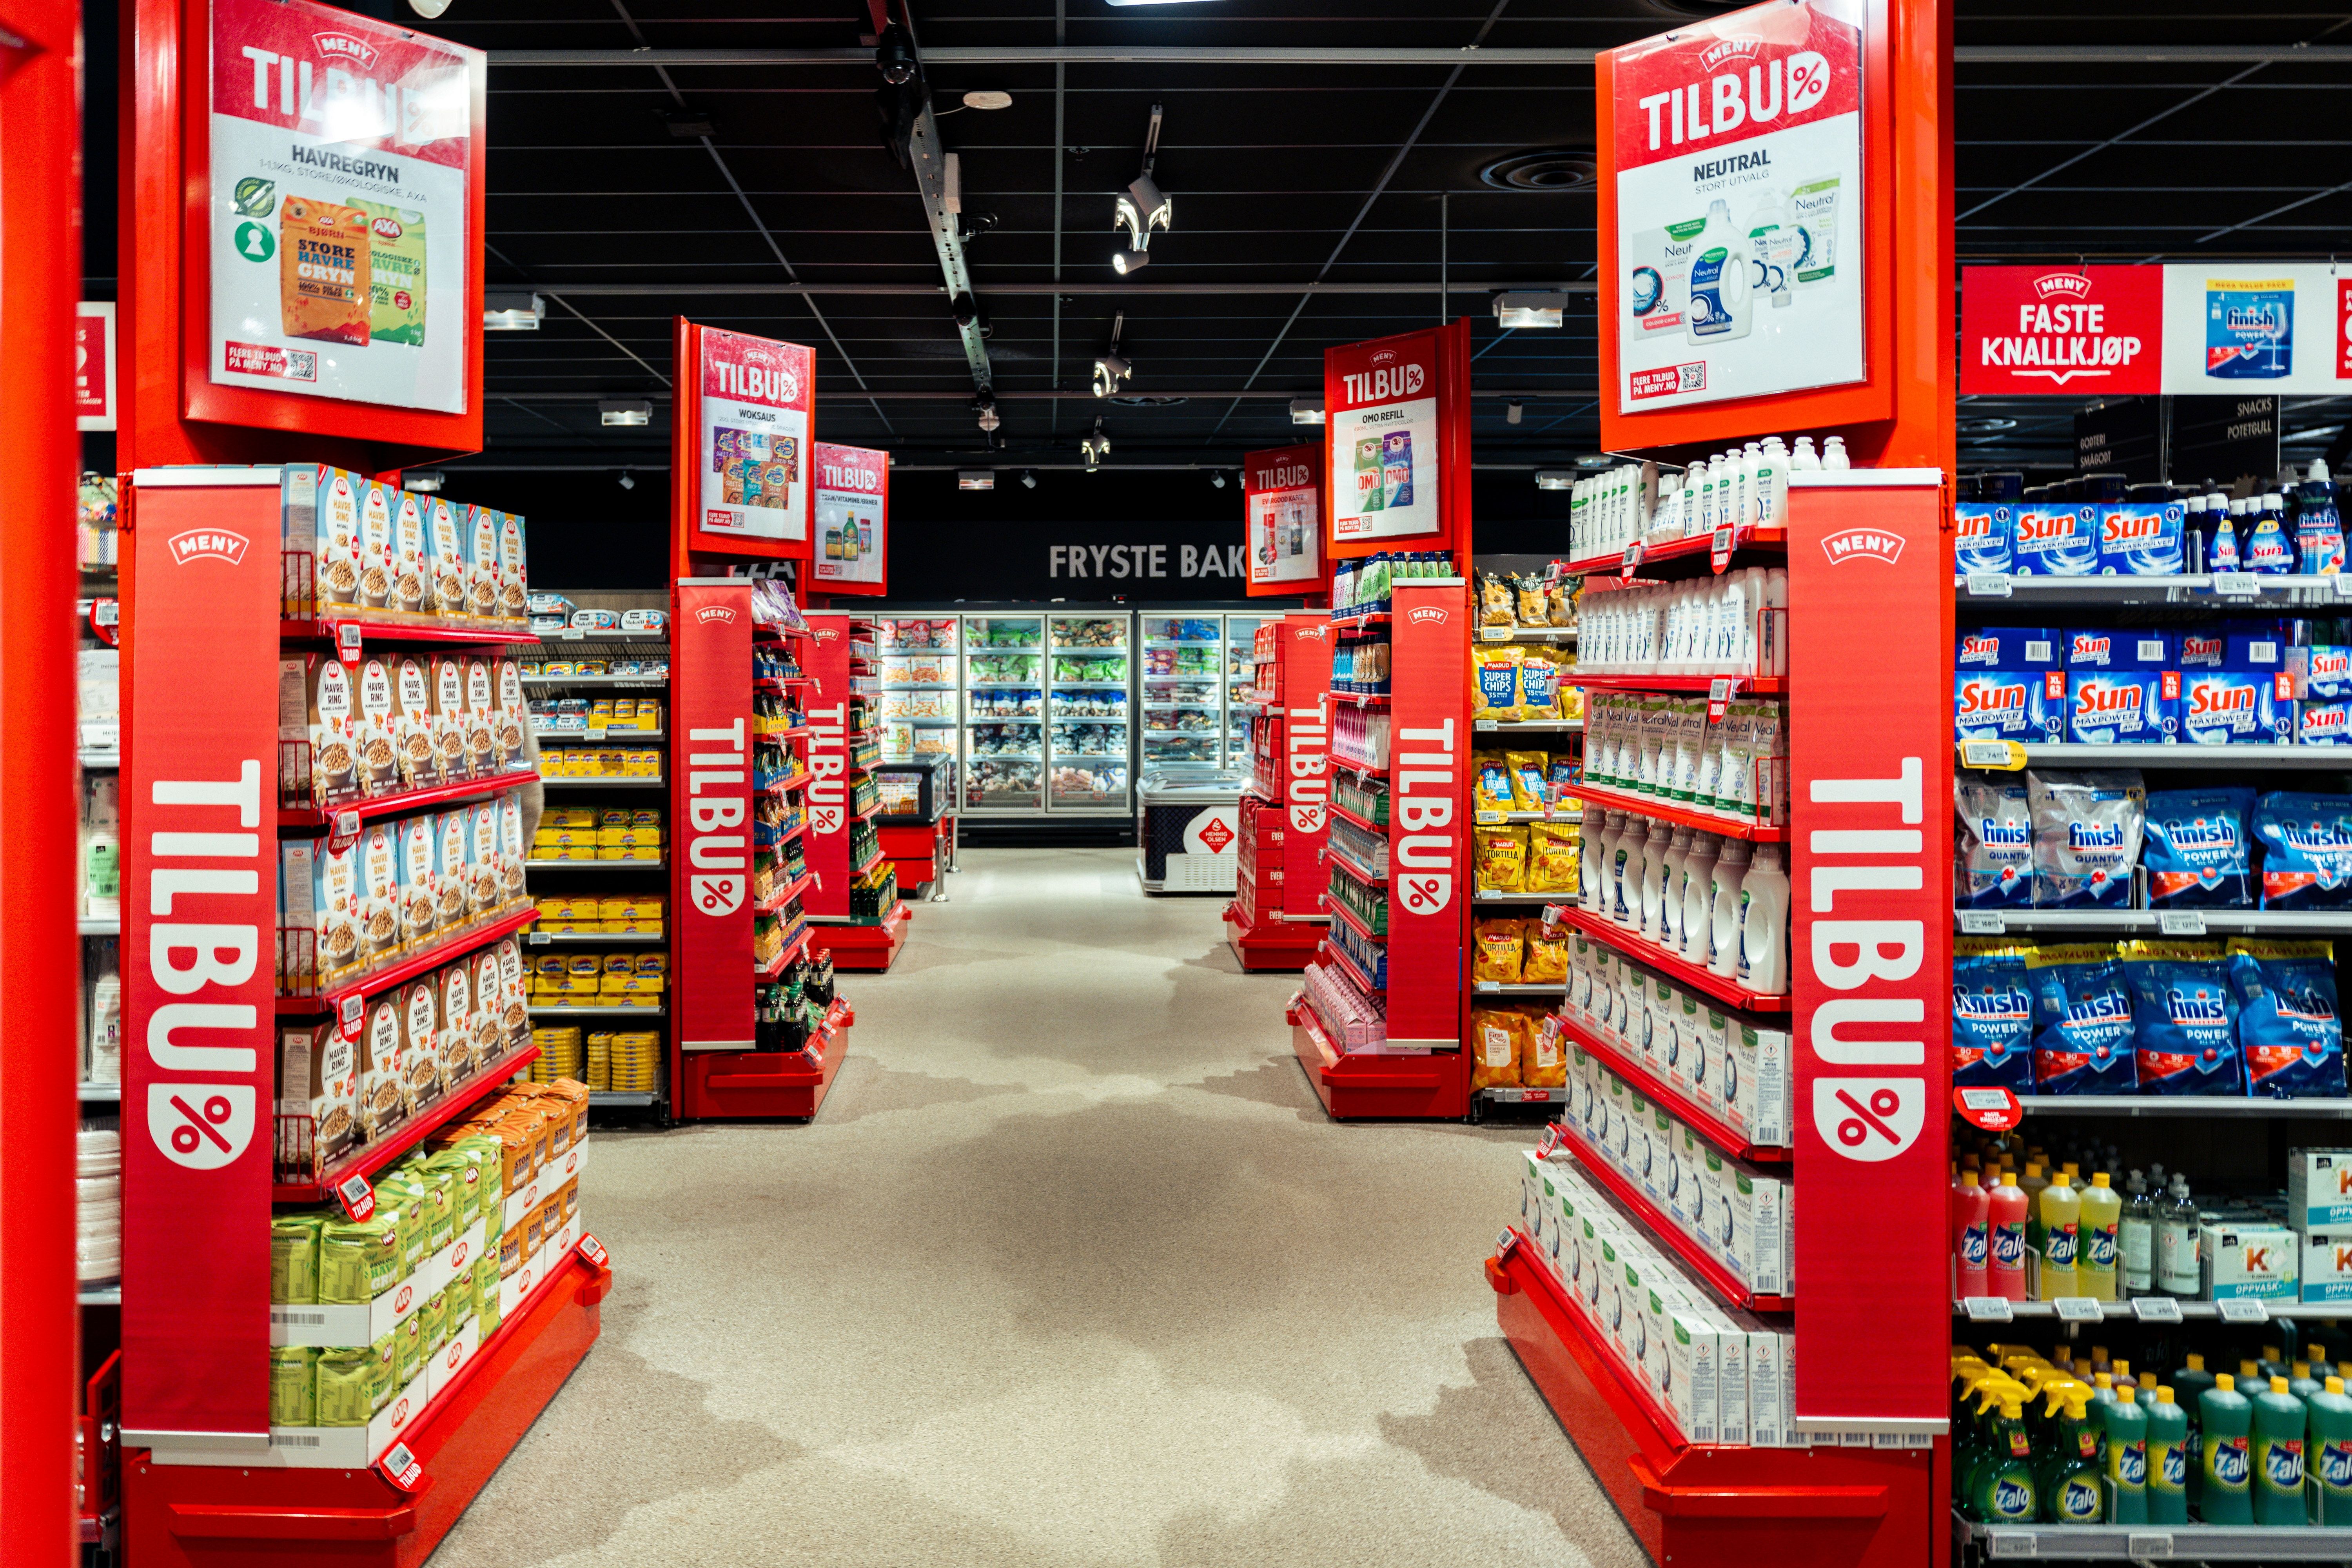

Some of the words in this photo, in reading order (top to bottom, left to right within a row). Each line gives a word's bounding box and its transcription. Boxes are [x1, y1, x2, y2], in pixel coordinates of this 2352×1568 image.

[321, 37, 372, 60] MENY
[1707, 40, 1757, 64] MENY
[291, 145, 399, 183] HAVREGRYN
[1693, 149, 1771, 183] NEUTRAL
[1695, 181, 1728, 195] STORT
[1729, 169, 1770, 188] UTVALG
[407, 191, 427, 203] AXA
[1795, 192, 1835, 211] Neutral
[319, 217, 334, 225] AXA
[373, 220, 402, 236] AXA
[309, 227, 344, 239] BJØRN
[298, 239, 355, 258] STORE
[298, 252, 355, 270] HAVRE
[298, 263, 354, 285] GRYN
[1695, 266, 1719, 277] Neutral
[2042, 280, 2086, 292] MENY
[2020, 304, 2104, 334] FASTE
[2228, 307, 2274, 325] finish
[229, 347, 253, 358] FLERE
[254, 351, 282, 363] TILBUD
[747, 352, 771, 365] MENY
[1373, 353, 1394, 363] MENY
[1982, 336, 2141, 367] KNALLKJØP
[229, 358, 241, 368] PÅ
[243, 359, 283, 373] MENY.NO
[1633, 375, 1651, 386] FLERE
[1651, 371, 1675, 383] TILBUD
[1633, 384, 1643, 396] PÅ
[1644, 380, 1677, 394] MENY.NO
[2237, 397, 2272, 417] SNACKS
[739, 409, 776, 422] WOKSAUS
[1363, 414, 1379, 423] OMO
[1381, 410, 1404, 421] REFILL
[2227, 419, 2272, 440] POTETGULL
[2080, 433, 2106, 450] GODTERI
[2080, 450, 2111, 469] SMÅGODT
[1358, 474, 1381, 490] OMO
[1385, 468, 1409, 485] OMO
[333, 499, 351, 511] HAVRE
[1262, 496, 1288, 505] EVERGOOD
[336, 512, 349, 523] RING
[2017, 514, 2076, 542] Sun
[2103, 514, 2161, 542] Sun
[178, 534, 240, 556] MENY
[1831, 534, 1895, 555] MENY
[2105, 537, 2173, 554] OPPVASKPULVER
[2253, 544, 2283, 559] Sun
[1050, 544, 1167, 578] FRYSTE
[1713, 554, 1728, 565] TILBUD
[701, 608, 732, 619] MENY
[1413, 612, 1444, 620] MENY
[2312, 654, 2348, 675] Sun
[1484, 671, 1511, 682] SUPER
[2050, 675, 2061, 685] XL
[368, 682, 384, 692] HAVRE
[1485, 681, 1511, 692] CHIPS
[370, 693, 383, 702] RING
[1960, 682, 2026, 713] Sun
[2077, 683, 2142, 714] Sun
[2190, 684, 2256, 715] Sun
[1710, 702, 1725, 716] TILBUD
[1959, 712, 2019, 725] MAXPOWER
[2189, 714, 2249, 726] MAXPOWER
[1485, 770, 1497, 779] SOM-
[1486, 780, 1508, 789] BREROS
[2069, 821, 2123, 846] finish
[2164, 817, 2234, 845] finish
[370, 852, 388, 866] HAVRE
[1487, 850, 1518, 860] TORTILLA
[2184, 850, 2228, 861] POWER
[330, 864, 347, 877] HAVRE
[374, 864, 387, 875] RING
[1270, 871, 1284, 880] EVER
[333, 877, 347, 887] RING
[1483, 943, 1516, 952] TORTILLA
[1628, 985, 1642, 1001] Neutral
[1653, 999, 1670, 1016] Neutral
[343, 1019, 363, 1037] TILBUD
[377, 1022, 393, 1037] HAVRE
[1972, 1023, 2018, 1034] POWER
[379, 1034, 392, 1046] RING
[1706, 1028, 1724, 1046] Neutral
[329, 1046, 347, 1060] HAVRE
[1738, 1045, 1756, 1065] Neutral
[331, 1058, 345, 1069] RING
[465, 1167, 479, 1183] AXA
[352, 1199, 374, 1220] TILBUD
[1992, 1232, 2025, 1258] Zalo
[592, 1249, 606, 1265] TILBUD
[2247, 1247, 2269, 1272] K
[392, 1399, 408, 1428] AXA
[2266, 1454, 2303, 1479] Zalo
[399, 1463, 421, 1488] TILBUD
[1995, 1486, 2030, 1510] Zalo
[2065, 1488, 2098, 1512] Zalo
